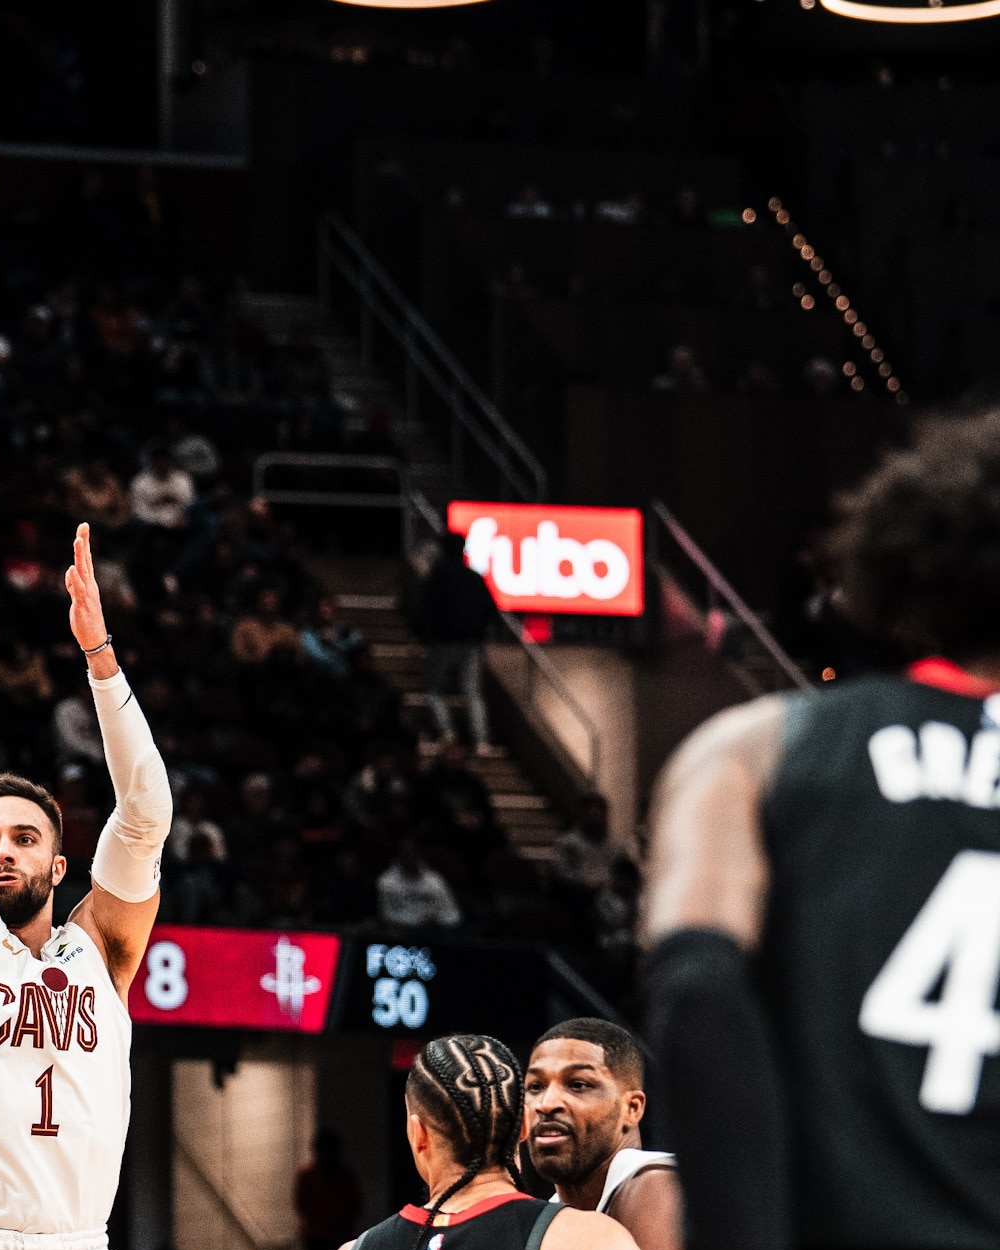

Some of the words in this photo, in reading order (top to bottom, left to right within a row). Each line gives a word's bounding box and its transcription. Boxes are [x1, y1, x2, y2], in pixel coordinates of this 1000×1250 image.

[463, 516, 631, 600] fubo
[371, 977, 430, 1029] 50
[31, 1063, 60, 1137] 1
